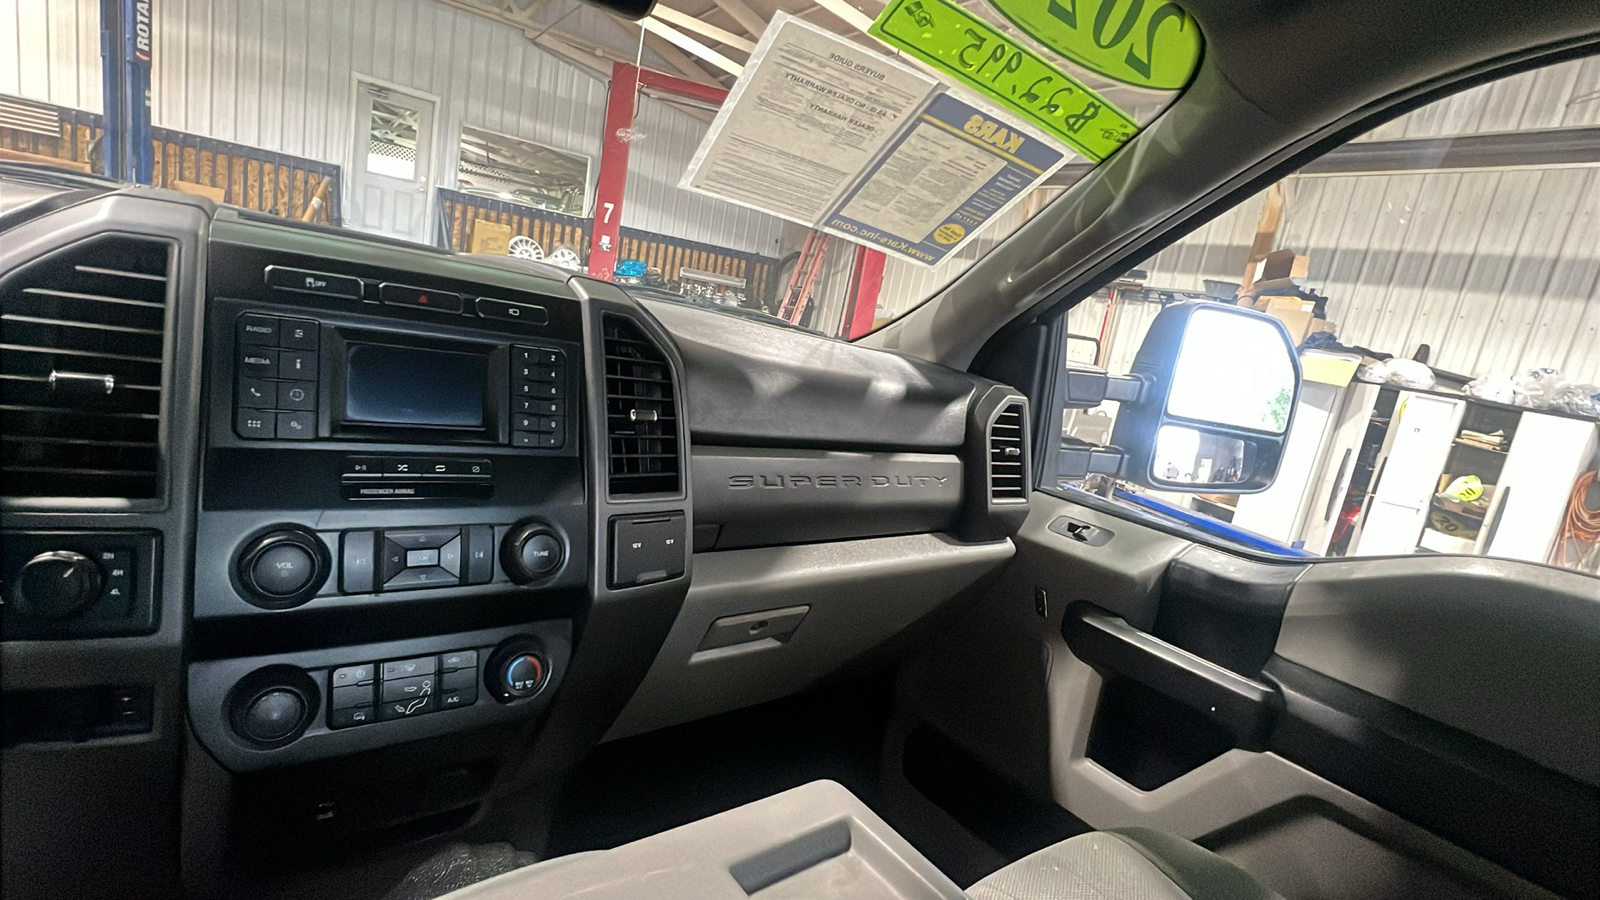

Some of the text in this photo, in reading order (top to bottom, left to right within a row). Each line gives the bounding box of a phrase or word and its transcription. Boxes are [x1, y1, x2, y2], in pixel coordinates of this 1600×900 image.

[136, 0, 150, 51] ROTA
[603, 202, 615, 224] 7
[728, 474, 948, 490] SUPER DUTY
